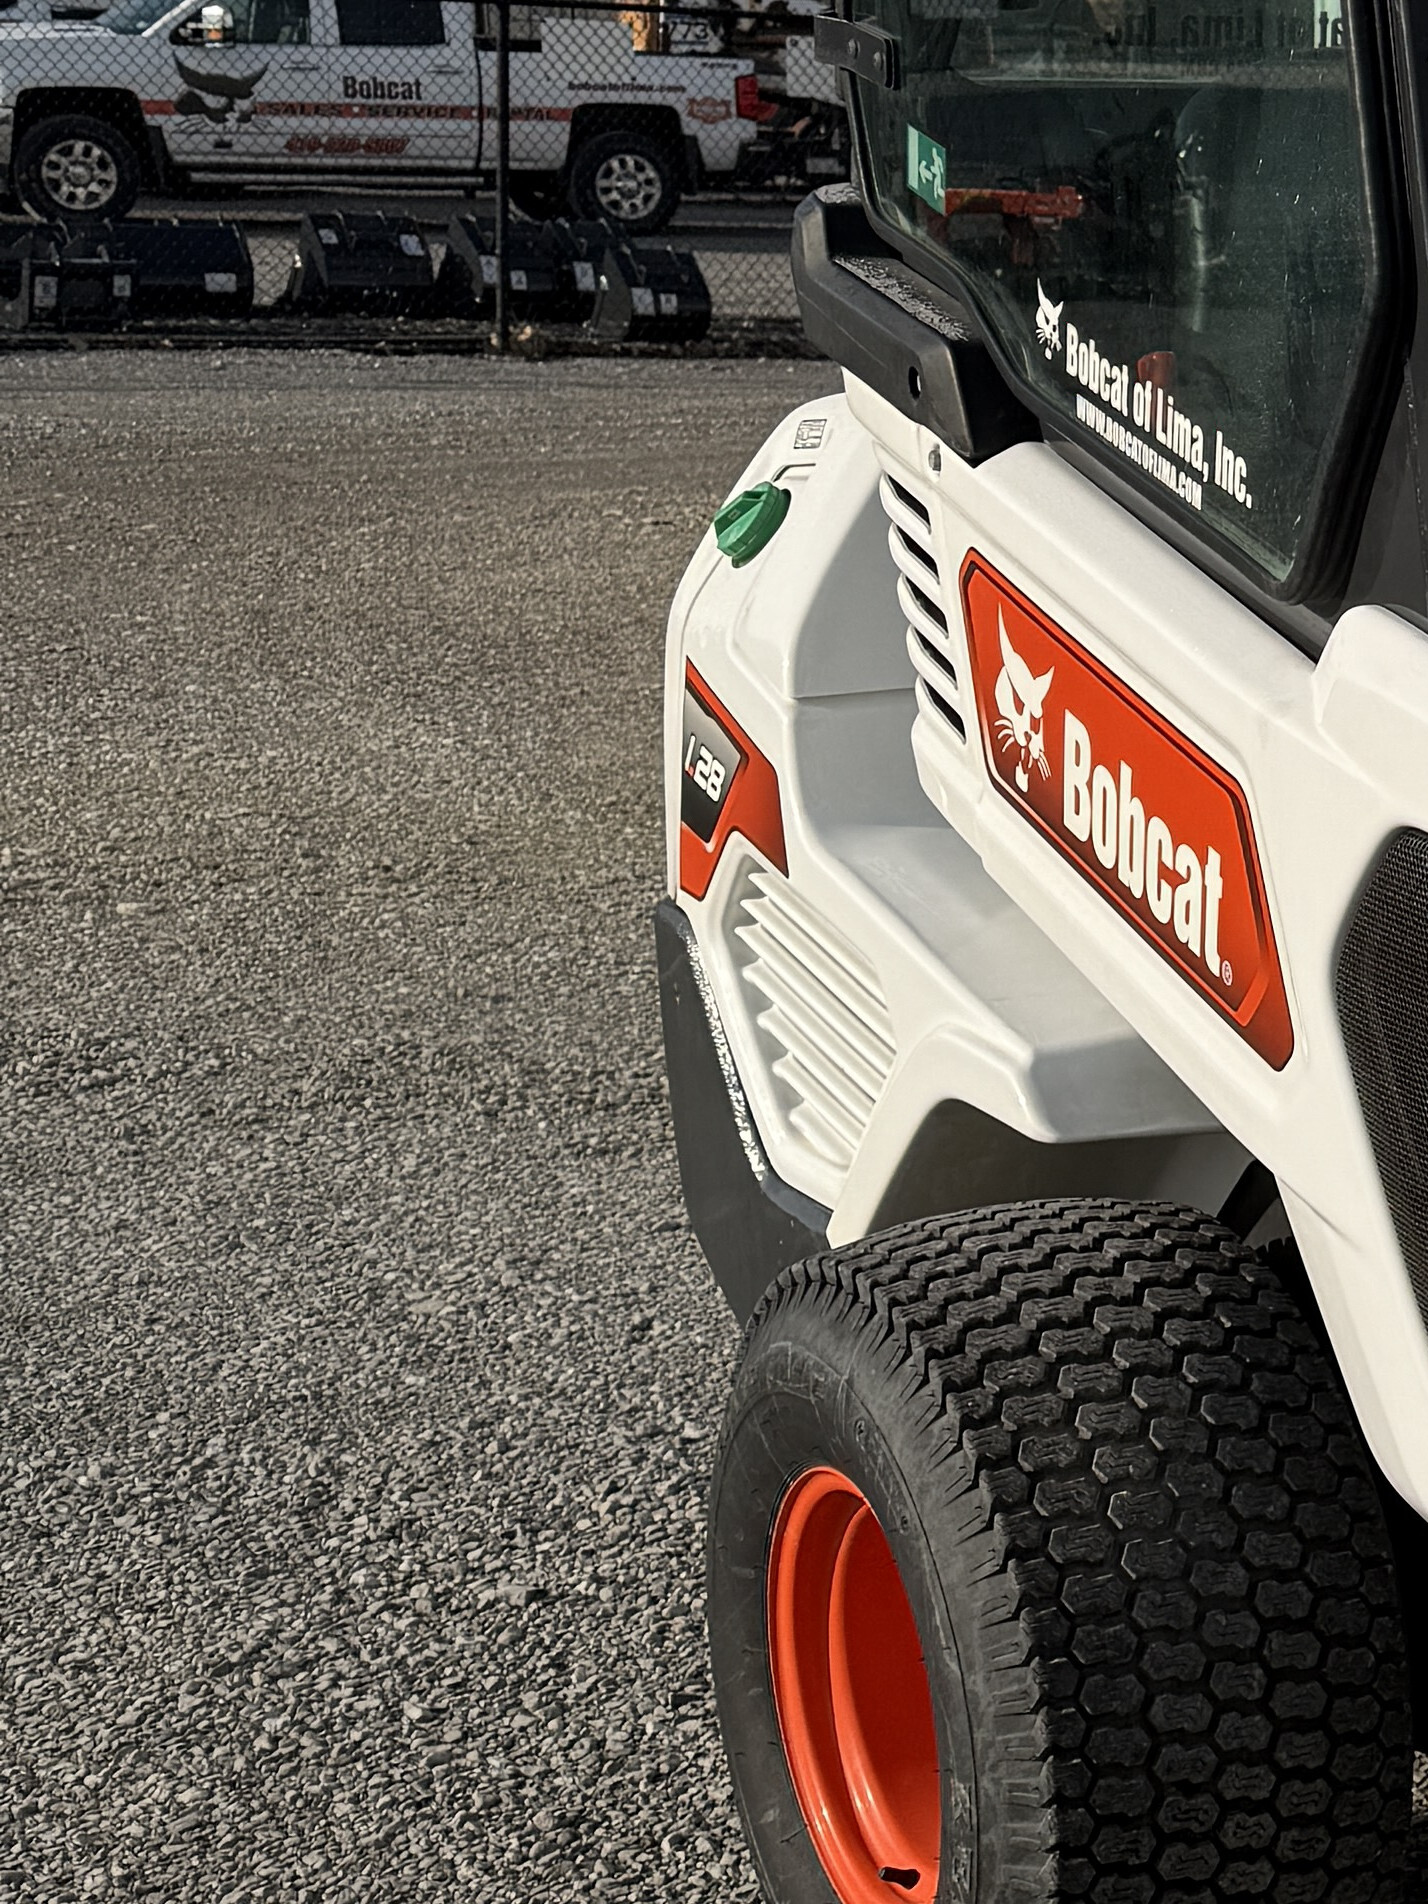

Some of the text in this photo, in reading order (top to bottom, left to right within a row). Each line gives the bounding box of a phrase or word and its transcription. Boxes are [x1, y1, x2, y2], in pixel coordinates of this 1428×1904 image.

[342, 76, 422, 101] Bobcat
[486, 106, 555, 121] RNTAL
[1065, 322, 1253, 510] Bobcat of Lima, Inc.
[1063, 707, 1224, 978] Bobcat
